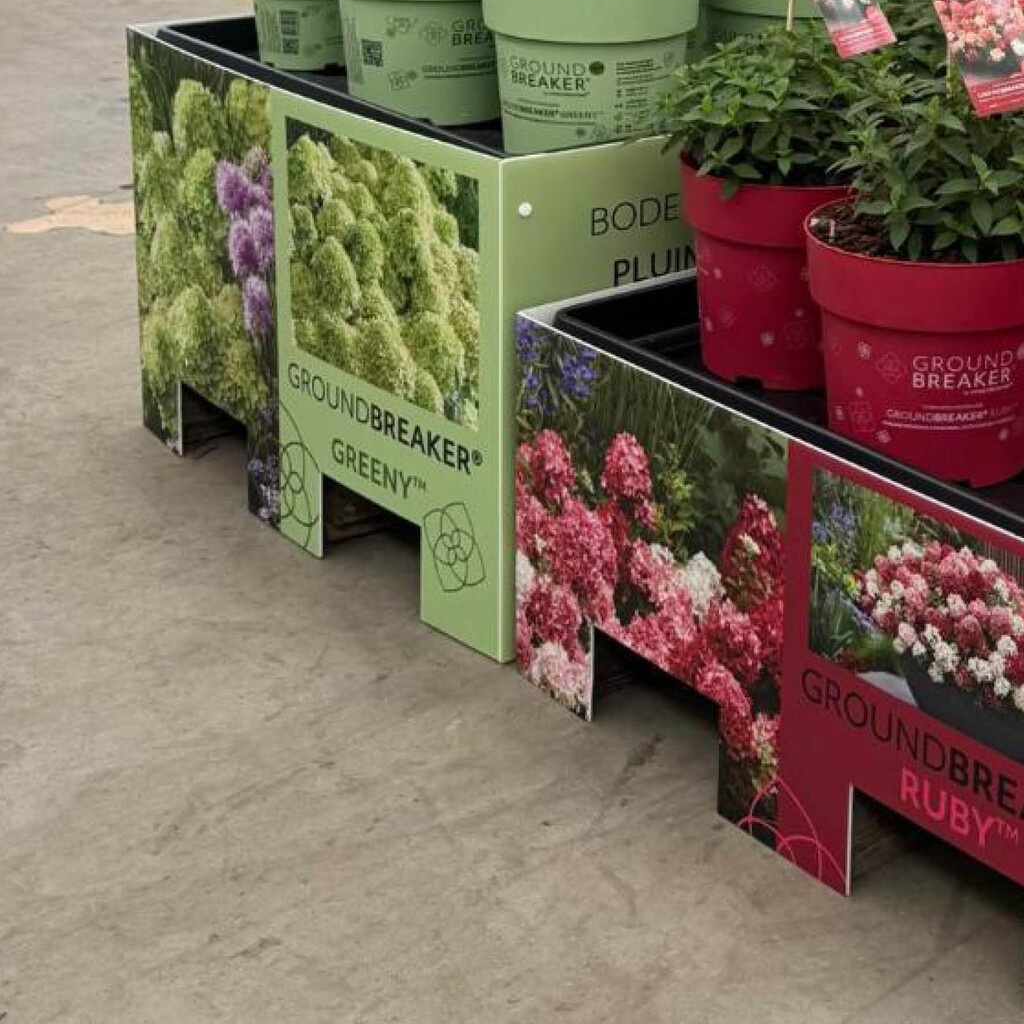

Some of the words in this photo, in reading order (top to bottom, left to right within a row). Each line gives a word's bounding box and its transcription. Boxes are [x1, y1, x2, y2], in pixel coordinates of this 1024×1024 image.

[509, 55, 586, 77] GROUND
[912, 367, 1012, 389] BREAKER
[913, 350, 1014, 372] GROUND
[287, 362, 484, 475] GROUNDBREAKER®
[331, 438, 427, 499] GREENY™
[900, 766, 1020, 850] RUBY™
